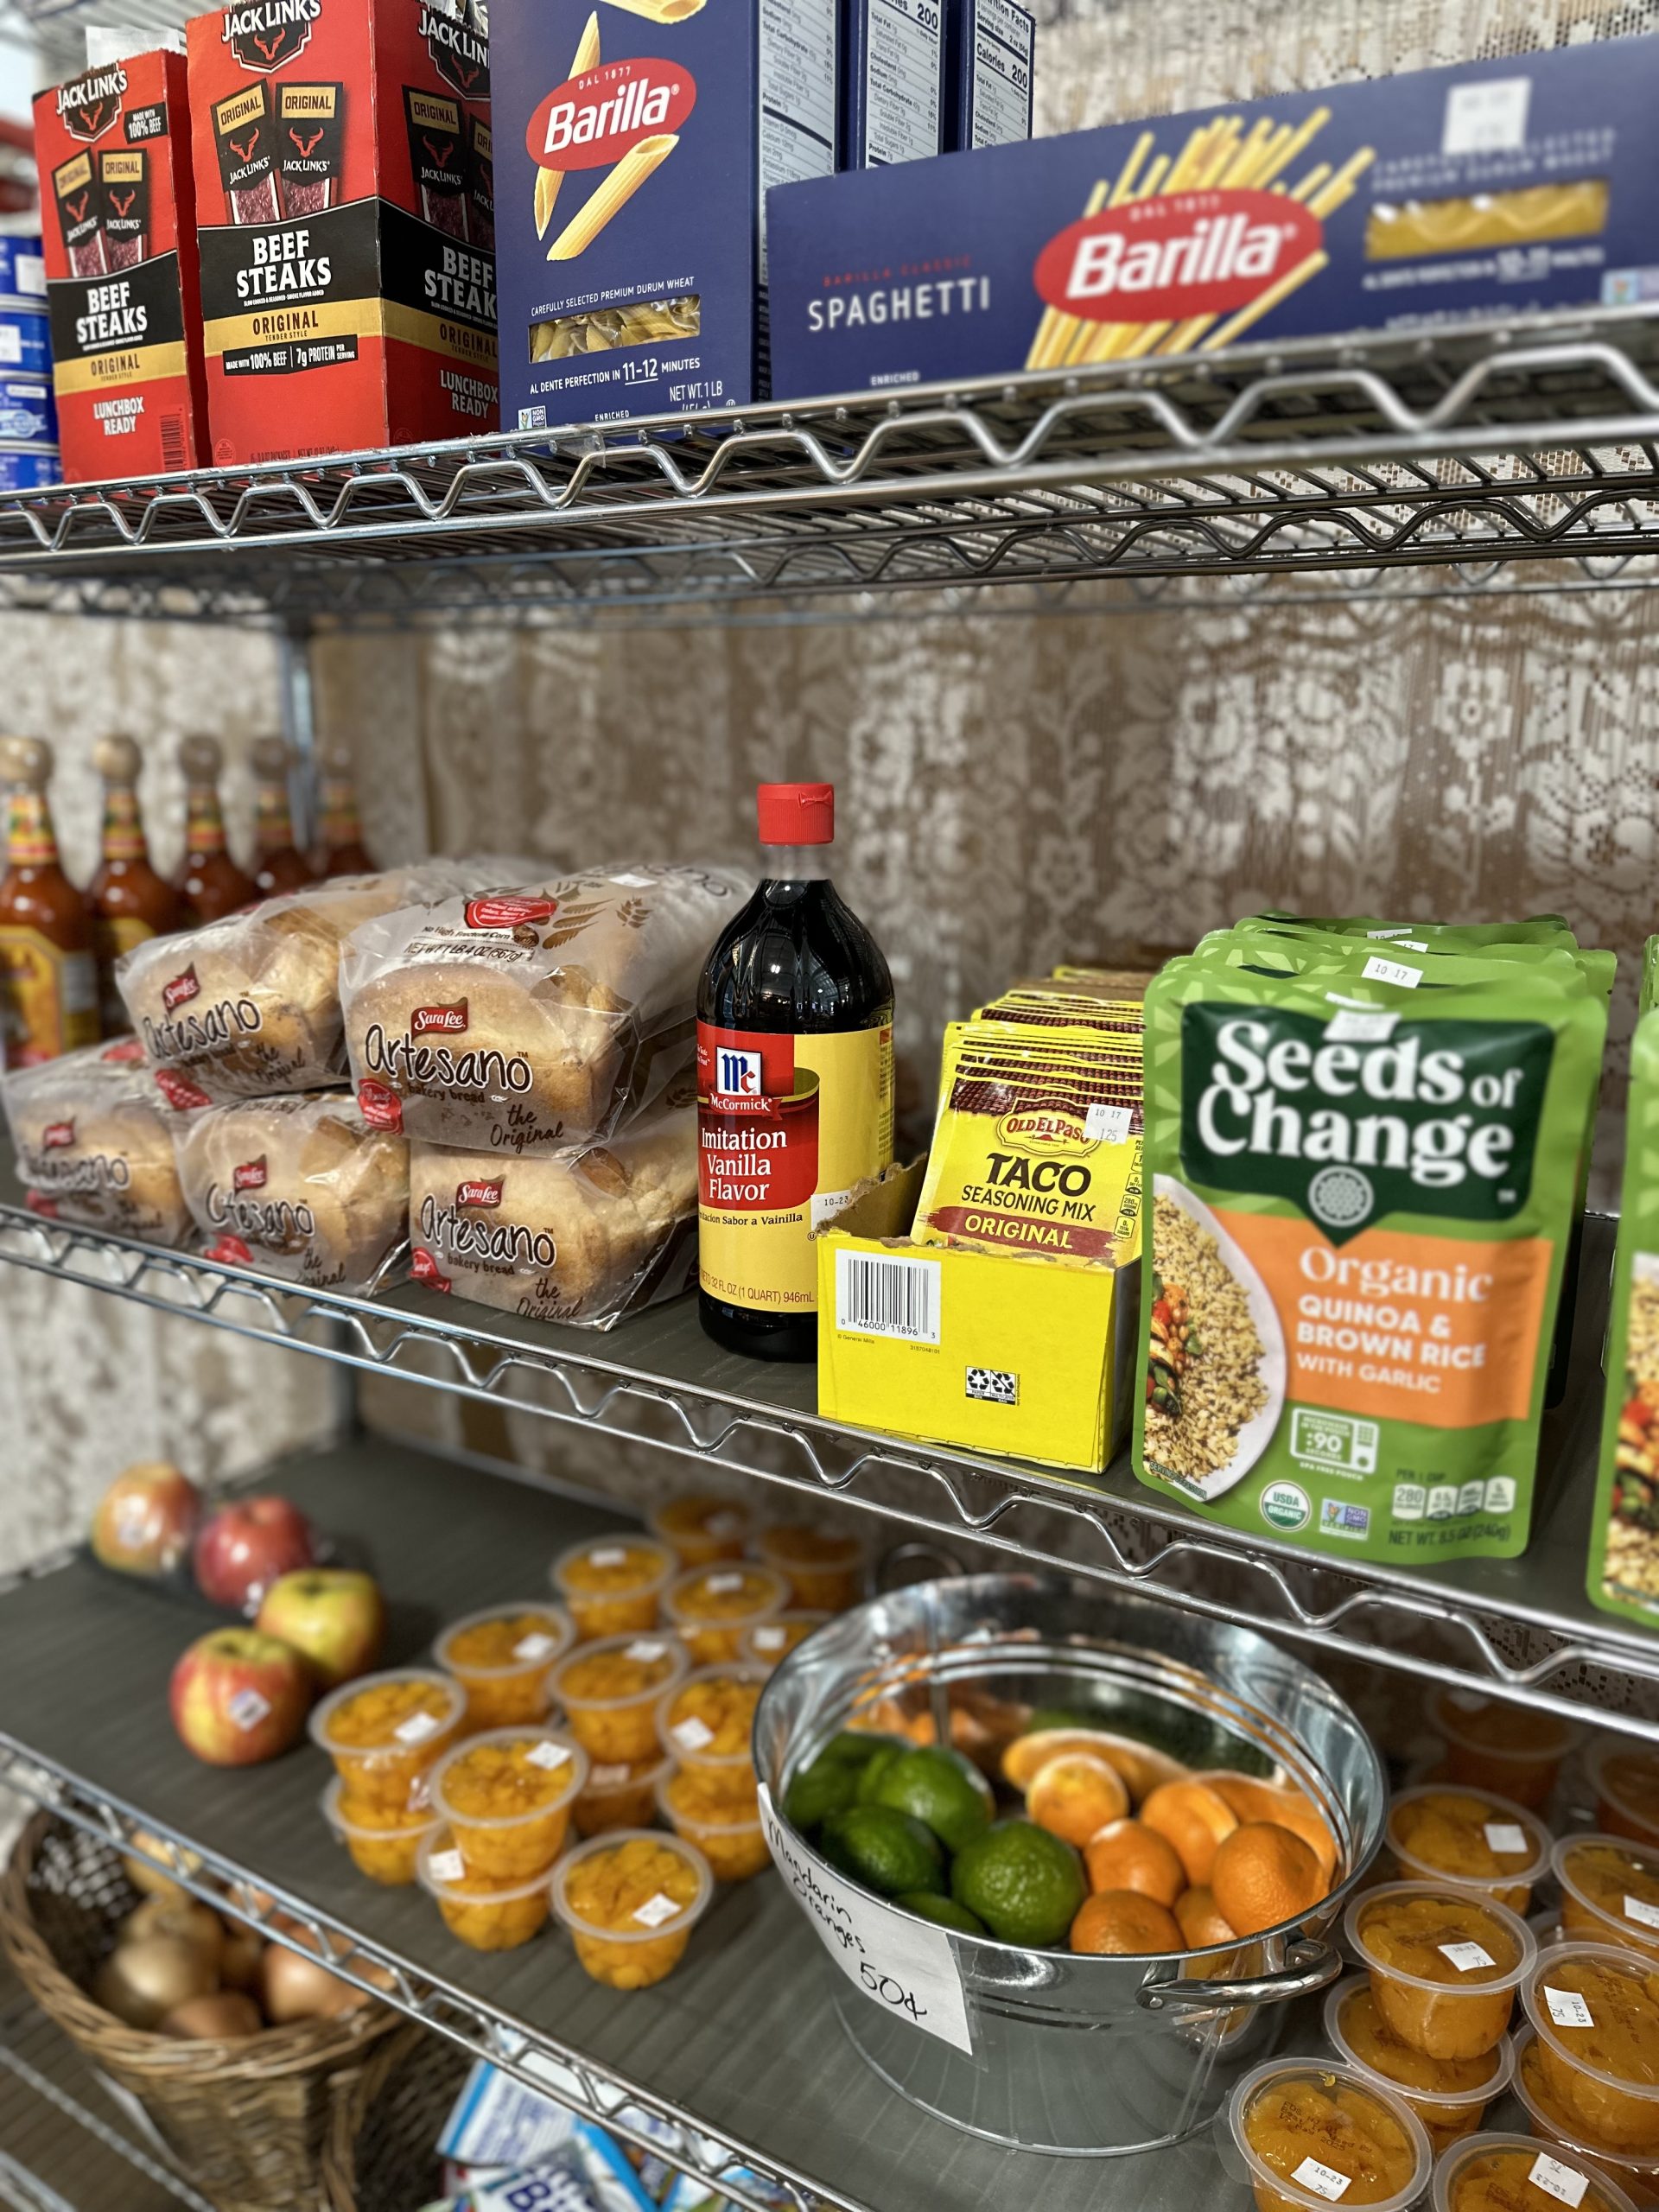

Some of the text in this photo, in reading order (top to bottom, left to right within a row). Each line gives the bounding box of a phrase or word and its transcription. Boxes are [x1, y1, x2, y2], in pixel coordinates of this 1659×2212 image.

[222, 9, 264, 42] JACK
[917, 3, 938, 30] 200
[1011, 9, 1029, 34] Facts
[418, 9, 461, 55] JACK
[976, 42, 1005, 73] Calories
[1012, 64, 1027, 89] 200
[579, 66, 632, 90] DAL 1877
[57, 84, 86, 114] JACK
[220, 95, 262, 126] ORIGINAL
[285, 95, 332, 111] ORIGINAL
[414, 100, 457, 126] ORIGINAL
[544, 78, 671, 155] Barilla
[129, 117, 162, 138] 100% BEEF
[105, 162, 140, 175] ORIGINAL
[229, 168, 248, 185] JACK
[283, 160, 302, 172] JACK
[253, 230, 310, 266] BEEF
[1065, 213, 1283, 300] Barilla
[236, 257, 332, 298] STEAKS
[442, 245, 493, 289] BEEF
[87, 282, 130, 315] BEEF
[424, 269, 498, 320] STEAK
[531, 276, 695, 317] CAREFULLY SELECTED PREMIUM DURUM WHEAT
[808, 276, 990, 332] SPAGHETTI
[76, 306, 148, 343] STEAKS
[253, 310, 319, 335] ORIGINAL
[265, 330, 308, 342] TENDER STYLE
[440, 323, 498, 359] ORIGINAL
[91, 353, 140, 377] ORIGINAL
[226, 361, 238, 370] MADE
[250, 352, 272, 370] 100%
[272, 351, 288, 366] BEEF
[296, 346, 335, 366] 7g PROTEIN
[337, 351, 355, 360] SERVING
[440, 370, 499, 405] LUNCHBOX
[530, 358, 701, 395] AL DENTE PERFECTION IN 11-12 MINUTES
[870, 371, 920, 386] ENRICHED
[670, 385, 685, 403] NET
[687, 383, 703, 400] WT.
[711, 380, 723, 397] LB
[93, 397, 145, 419] LUNCHBOX
[452, 392, 489, 420] READY
[594, 410, 630, 422] ENRICHED
[104, 416, 137, 436] READY
[435, 926, 511, 940] High Corn
[448, 945, 467, 955] LB
[474, 946, 490, 957] OZ
[1375, 963, 1408, 980] 10 17
[365, 1024, 534, 1094] Artesano
[1211, 1020, 1524, 1109] Seeds of
[409, 1083, 485, 1104] bakery bread
[710, 1092, 771, 1112] McCormick
[506, 1104, 537, 1125] the
[1006, 1116, 1055, 1135] OLD EL
[1095, 1109, 1122, 1120] 10 17
[489, 1121, 564, 1154] Original
[701, 1127, 787, 1151] Imitation
[1197, 1083, 1515, 1189] Change
[707, 1154, 772, 1177] Vanilla
[986, 1152, 1091, 1197] TACO
[709, 1178, 770, 1201] Flavor
[961, 1185, 1096, 1222] SEASONING MIX
[420, 1193, 556, 1268] Artesano
[722, 1215, 748, 1225] Sabor
[761, 1213, 804, 1225] Vainilla
[964, 1214, 1073, 1250] ORIGINAL
[447, 1253, 515, 1275] bakery bread
[1299, 1246, 1494, 1303] Organic
[535, 1278, 561, 1299] the
[712, 1277, 718, 1288] 32
[719, 1280, 727, 1294] FL
[727, 1283, 737, 1296] OZ
[747, 1288, 782, 1305] QUART)
[784, 1291, 815, 1303] 946mL
[857, 1319, 886, 1332] 46000
[890, 1323, 918, 1337] 11896
[1298, 1294, 1452, 1339] QUINOA &
[1297, 1321, 1487, 1370] BROWN RICE
[1296, 1352, 1442, 1394] WITH GARLIC
[1274, 1491, 1300, 1507] USDA
[1397, 1486, 1424, 1503] 280
[1268, 1504, 1302, 1521] ORGANIC
[1346, 1514, 1367, 1522] GMO
[1348, 1506, 1367, 1516] NON
[1389, 1529, 1413, 1545] NET
[768, 1819, 852, 1924] Mandarin
[793, 1875, 866, 1954] Oranges
[1571, 2001, 1586, 2023] 10-23
[1314, 2166, 1343, 2185] 10-23
[1535, 2173, 1567, 2196] 10-23
